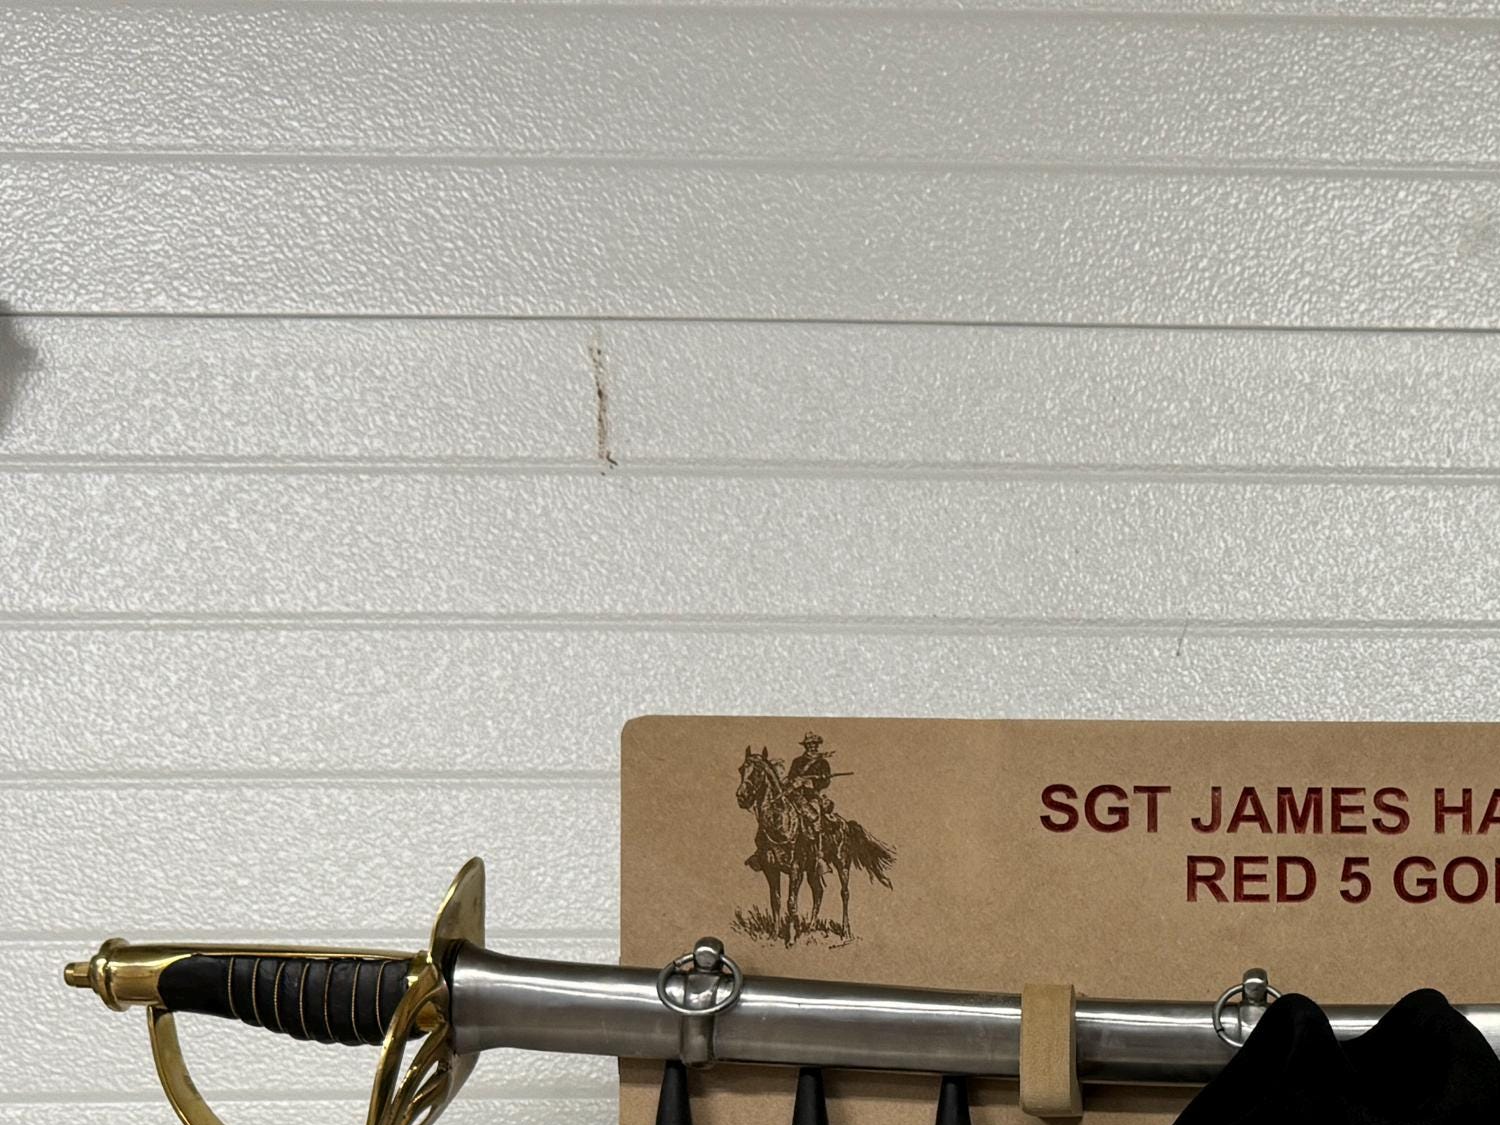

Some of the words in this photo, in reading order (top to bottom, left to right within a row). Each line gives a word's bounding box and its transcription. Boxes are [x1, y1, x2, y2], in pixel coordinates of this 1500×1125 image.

[1039, 783, 1172, 833] SGT
[1190, 785, 1410, 835] JAMES
[1186, 855, 1317, 903] RED
[1339, 856, 1372, 904] 5
